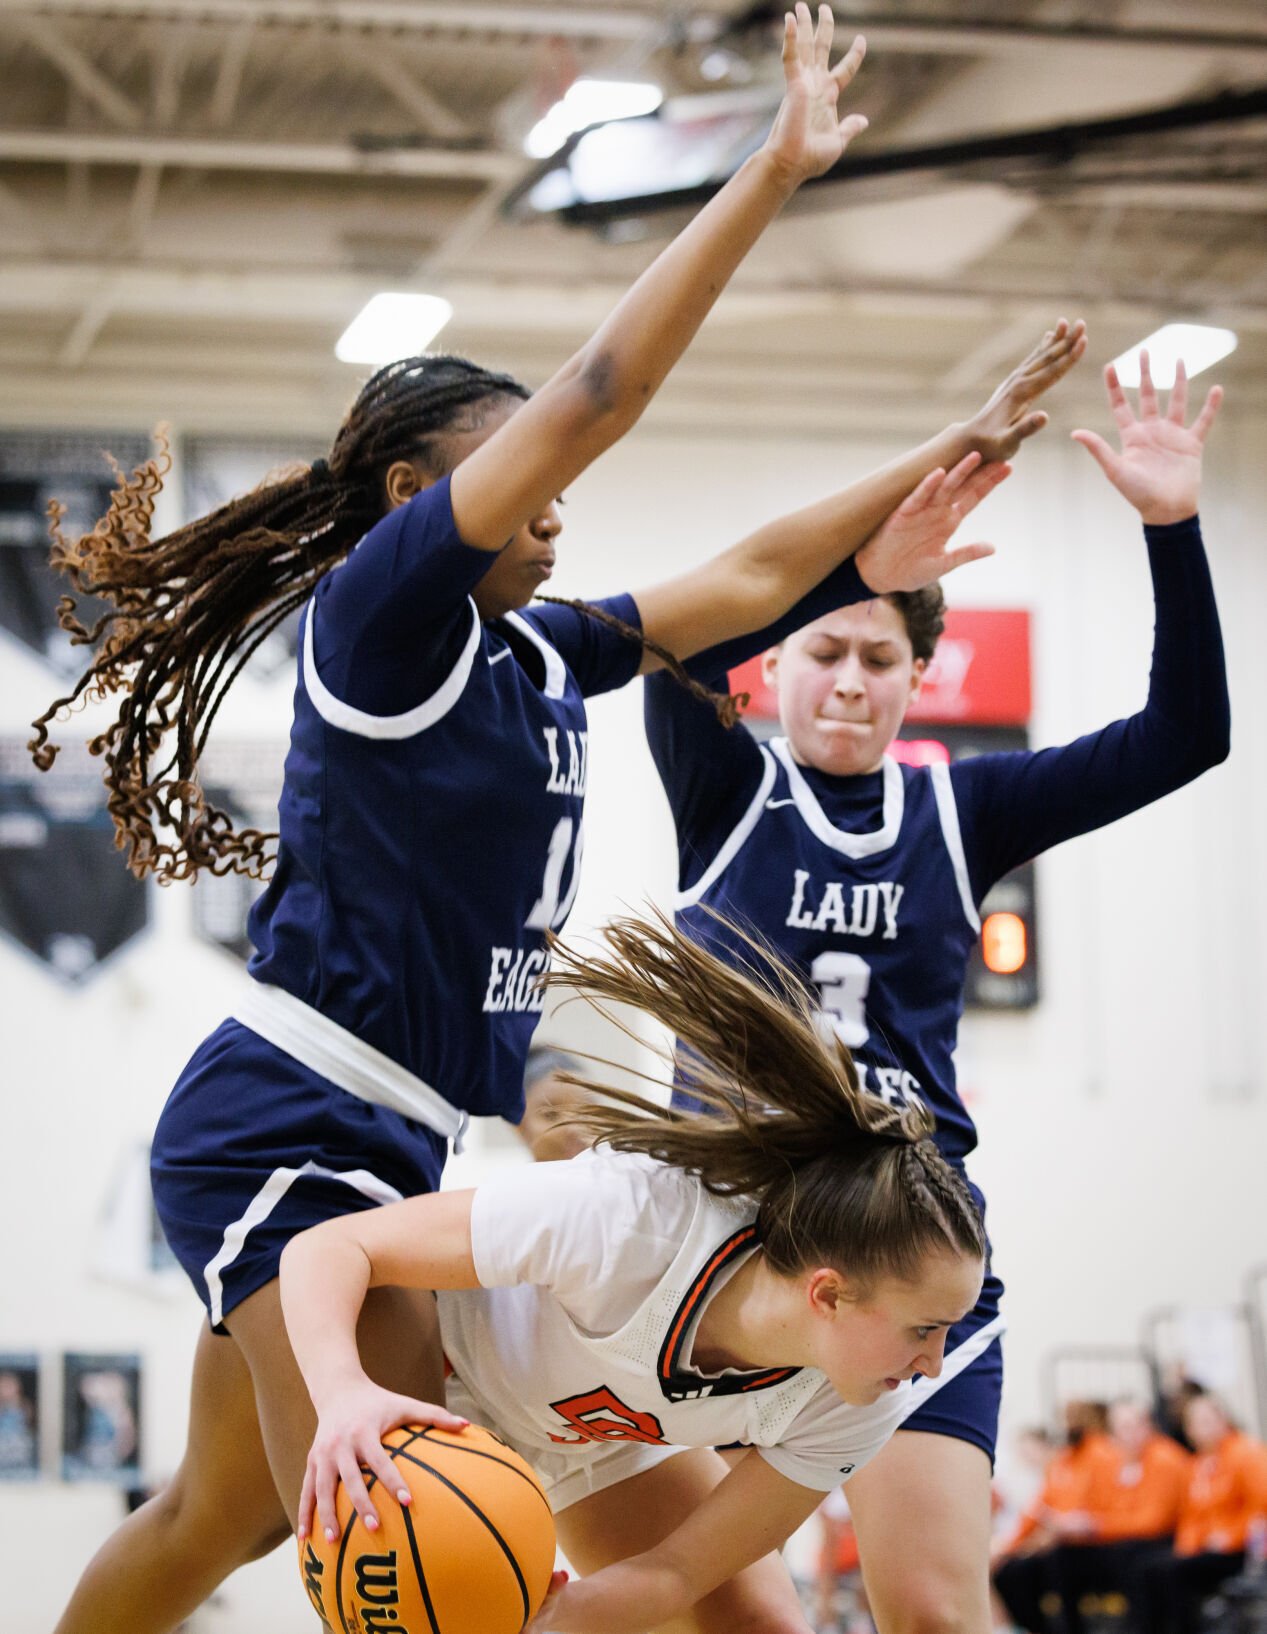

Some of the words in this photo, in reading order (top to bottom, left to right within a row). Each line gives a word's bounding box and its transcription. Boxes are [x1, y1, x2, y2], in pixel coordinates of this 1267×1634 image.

[543, 727, 588, 798] LA
[785, 868, 904, 939] LADY
[811, 951, 871, 1048] 3
